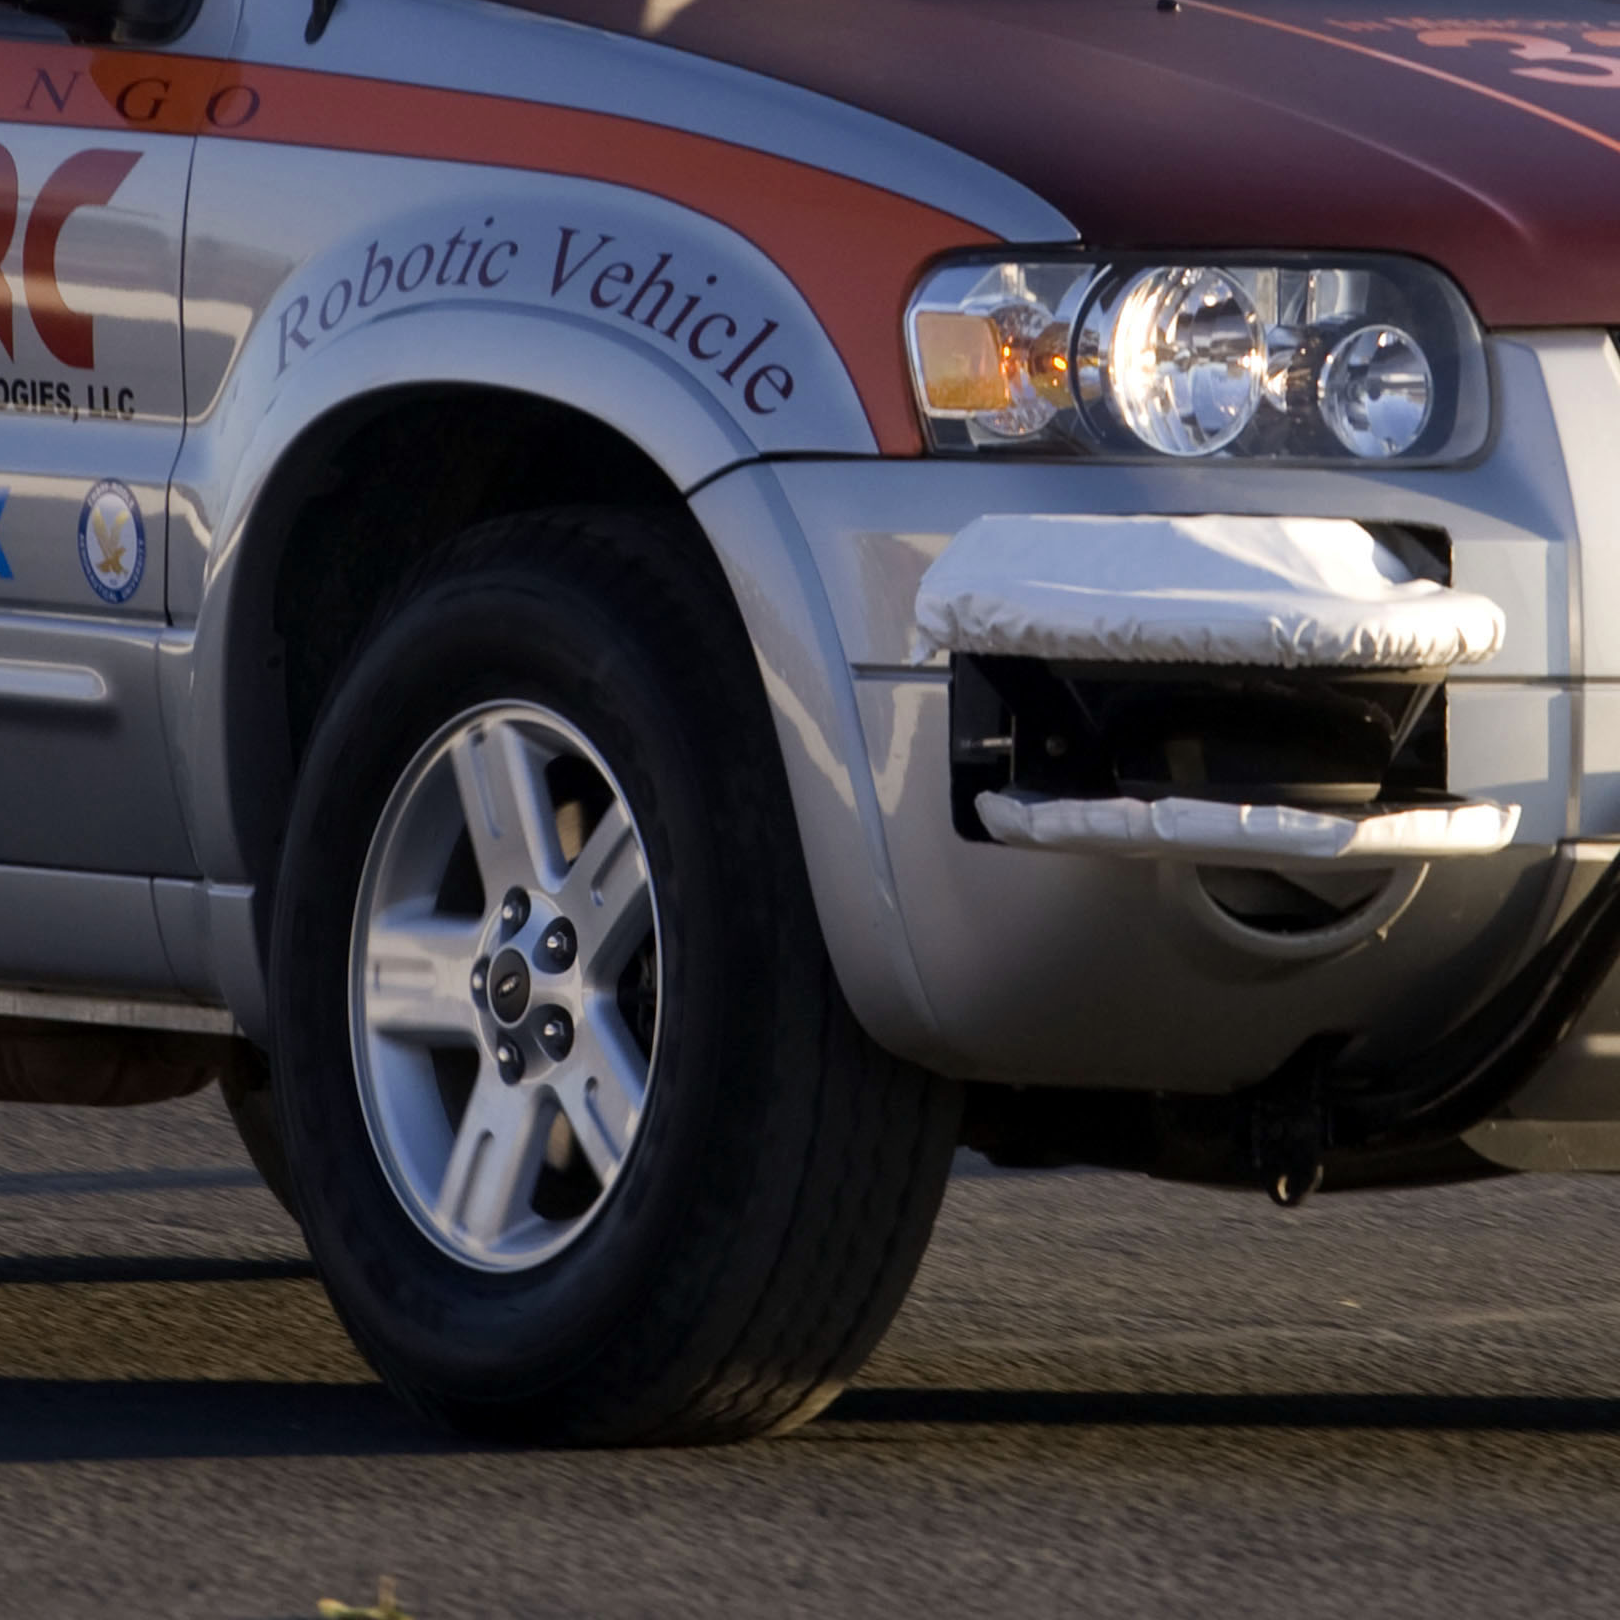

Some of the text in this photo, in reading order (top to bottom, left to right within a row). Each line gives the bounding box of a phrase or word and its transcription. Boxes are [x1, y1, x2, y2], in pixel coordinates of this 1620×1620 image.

[276, 216, 795, 416] Robotic Vehicle
[86, 383, 136, 421] LLC
